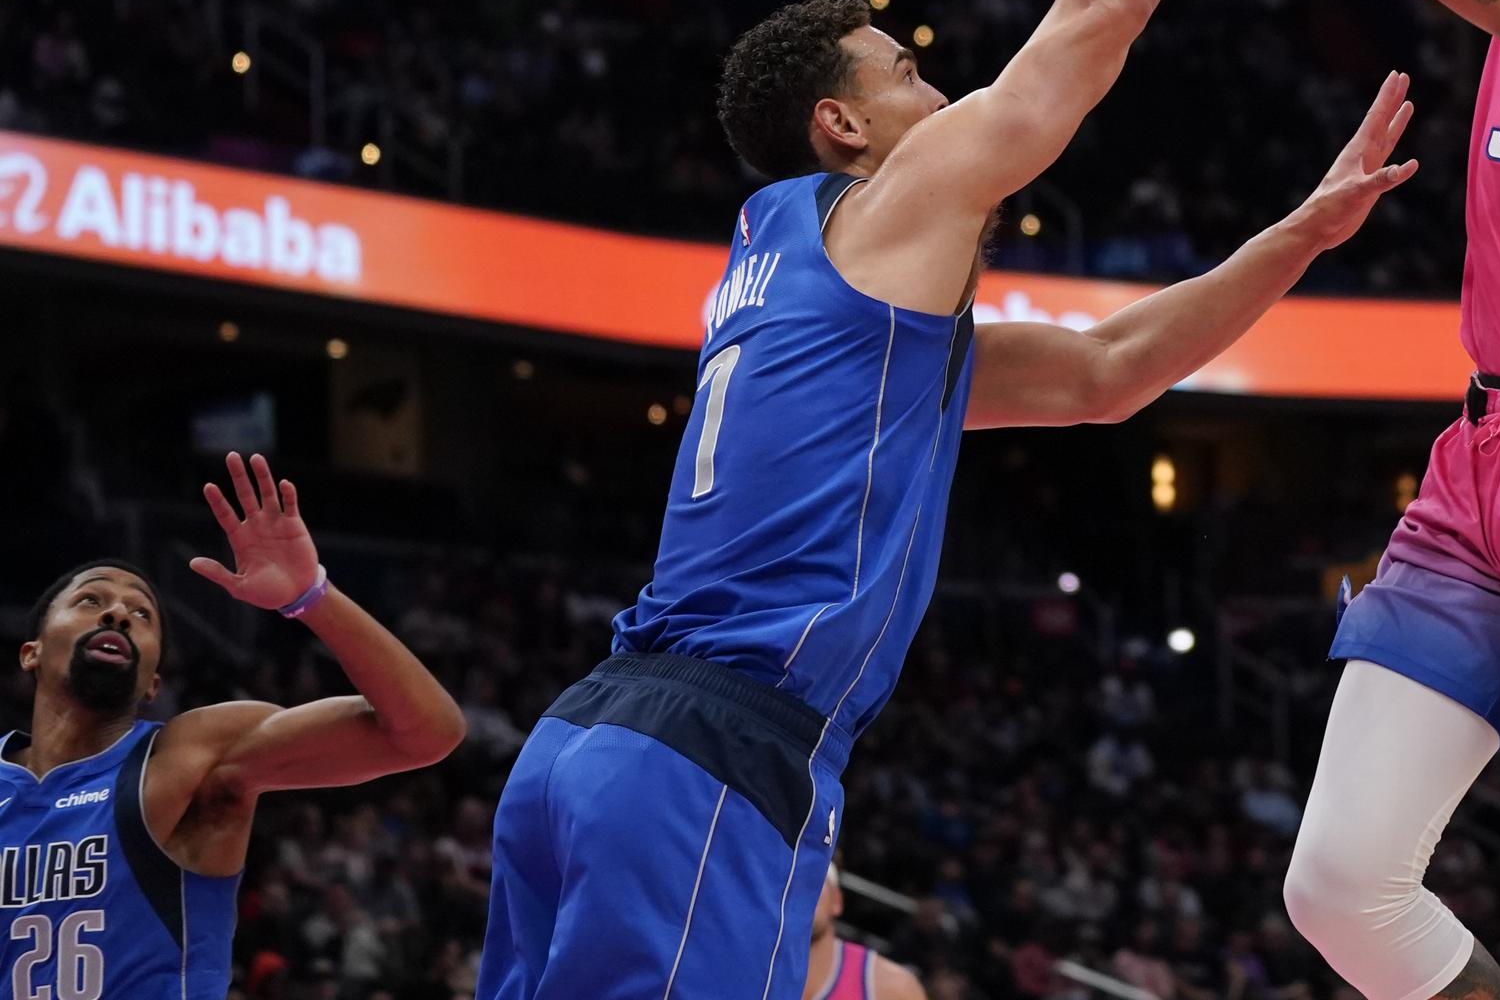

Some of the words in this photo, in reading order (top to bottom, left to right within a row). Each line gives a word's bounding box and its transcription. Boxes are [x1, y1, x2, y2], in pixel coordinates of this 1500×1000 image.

[56, 165, 363, 284] Alibaba
[706, 252, 781, 345] POWELL
[691, 344, 741, 500] 7
[54, 787, 110, 809] chime
[0, 834, 109, 908] LLAS
[10, 909, 105, 1000] 26
